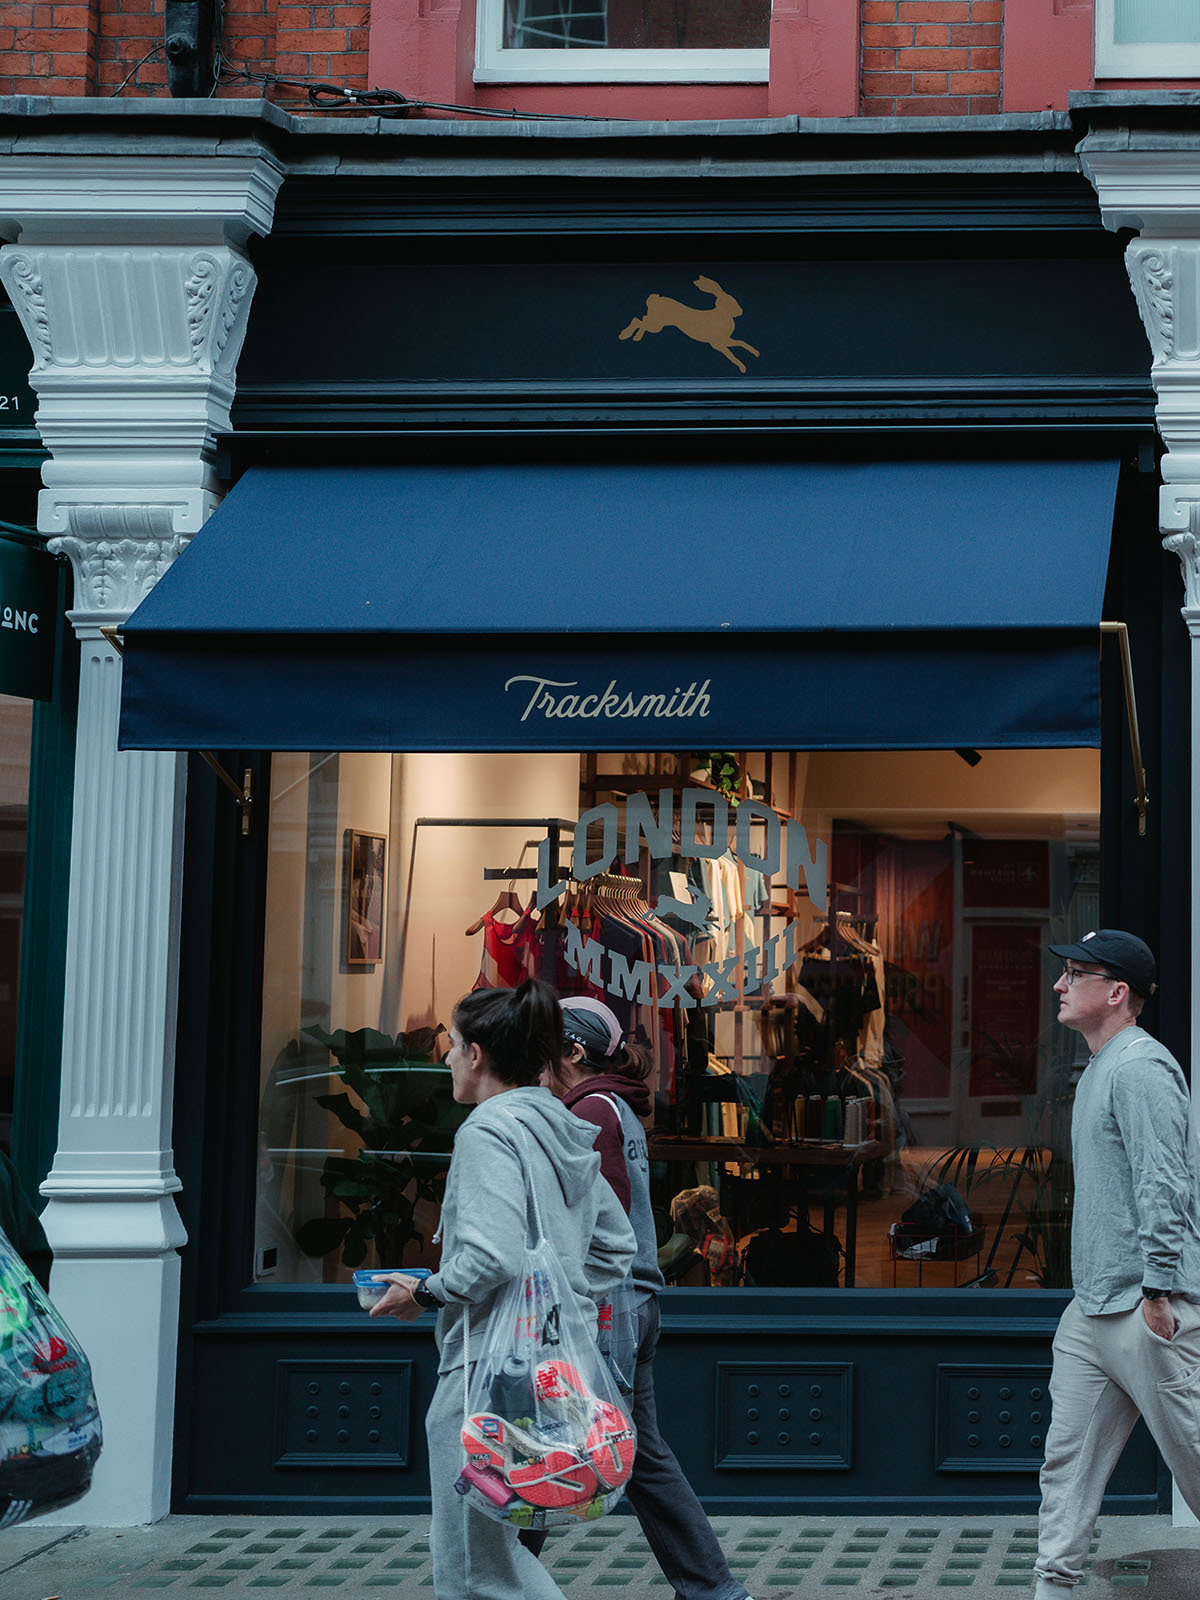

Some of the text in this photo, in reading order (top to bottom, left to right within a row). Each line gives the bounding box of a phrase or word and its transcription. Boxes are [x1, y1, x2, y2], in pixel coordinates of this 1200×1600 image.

[0, 397, 19, 411] 21
[0, 606, 39, 634] ONC
[505, 675, 711, 722] Tracksmith
[537, 788, 828, 912] LONDON
